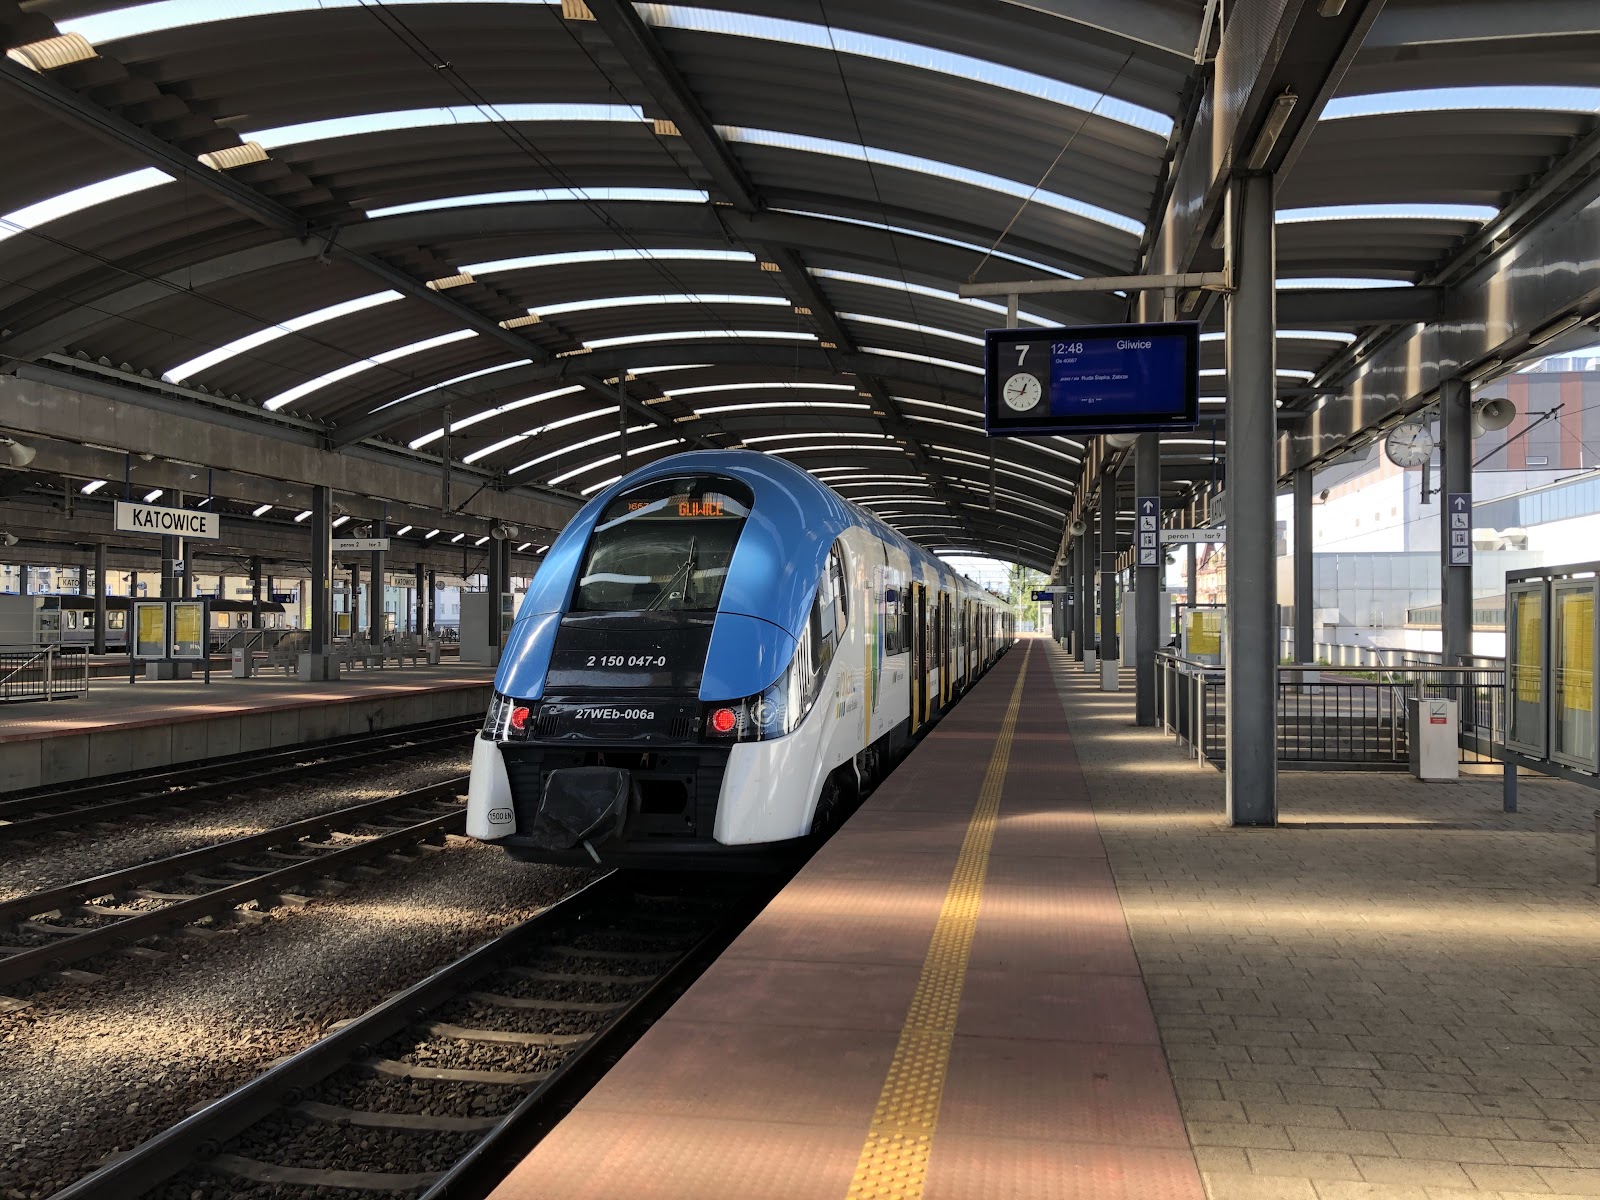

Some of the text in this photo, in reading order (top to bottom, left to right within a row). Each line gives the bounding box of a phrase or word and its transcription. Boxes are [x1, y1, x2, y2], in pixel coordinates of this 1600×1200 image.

[1050, 339, 1152, 355] 12:48 Gliwice
[1015, 344, 1030, 366] 7
[678, 502, 724, 516] GLIWICE
[132, 508, 207, 533] KATOWICE
[62, 579, 96, 588] KATOCE
[586, 655, 666, 667] 2 150 047-0
[575, 708, 655, 720] 27WEb-006a
[490, 812, 504, 821] 1500
